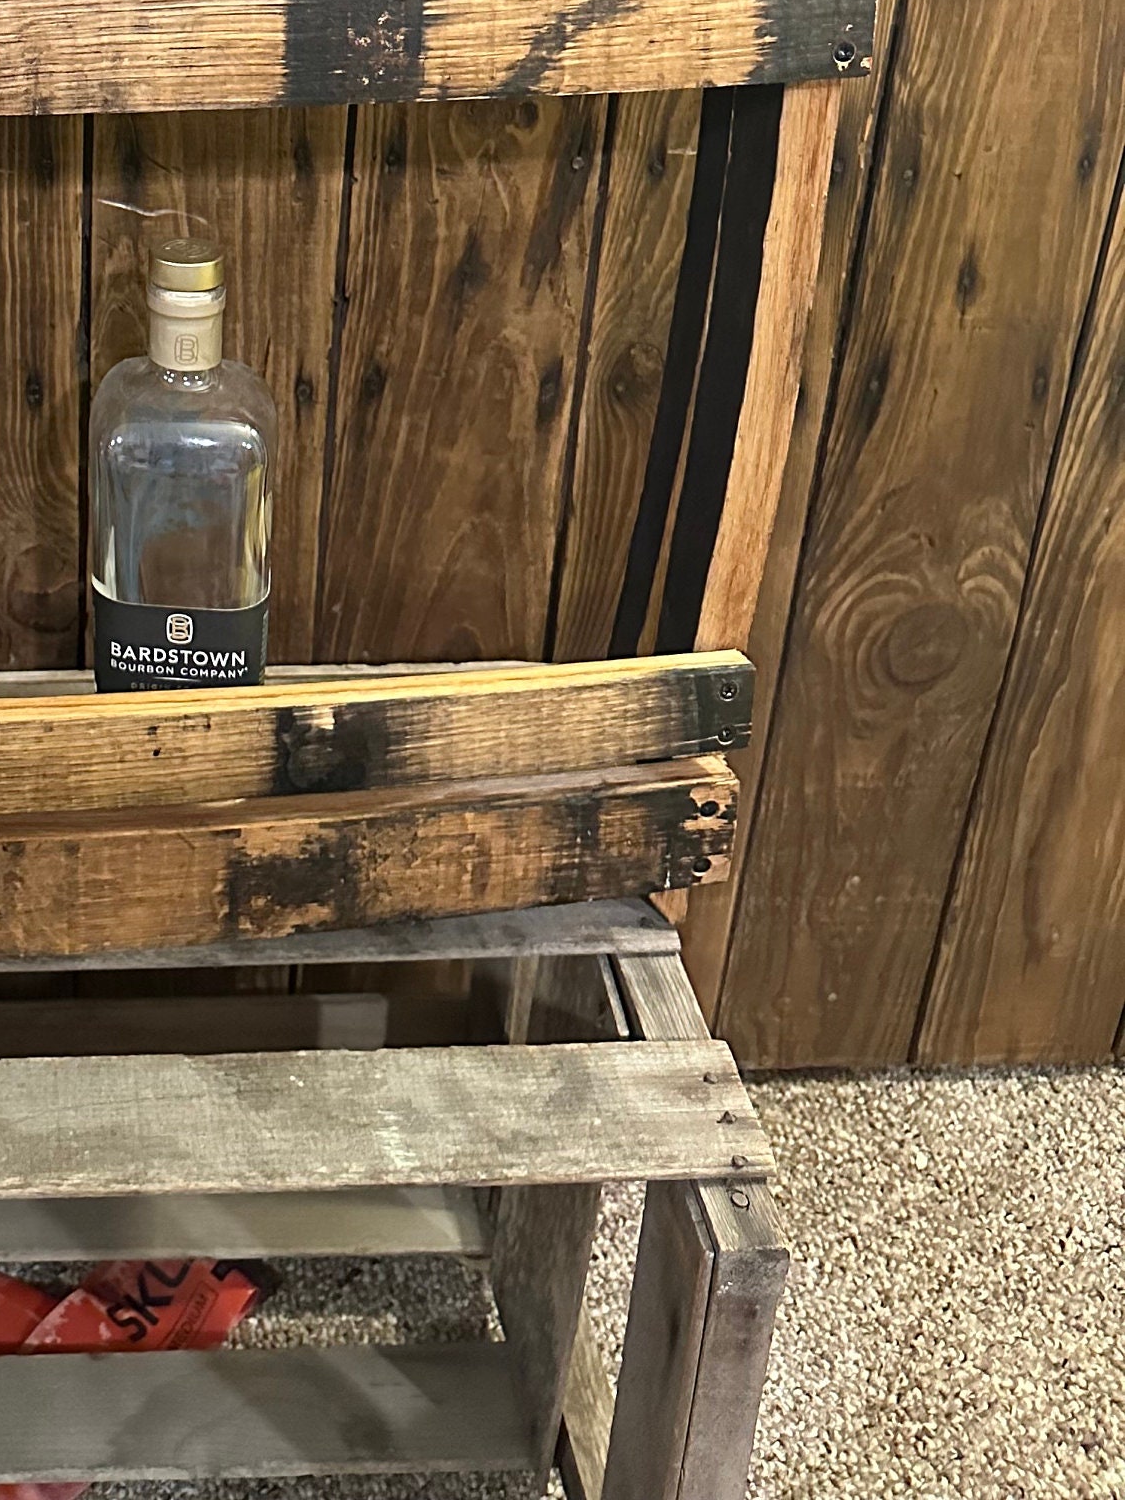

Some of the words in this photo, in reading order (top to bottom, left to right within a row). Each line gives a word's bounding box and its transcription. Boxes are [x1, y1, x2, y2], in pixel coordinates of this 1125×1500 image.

[111, 641, 245, 667] BARDSTOWN
[110, 658, 174, 676] BOURBON
[180, 667, 246, 679] COMPANY
